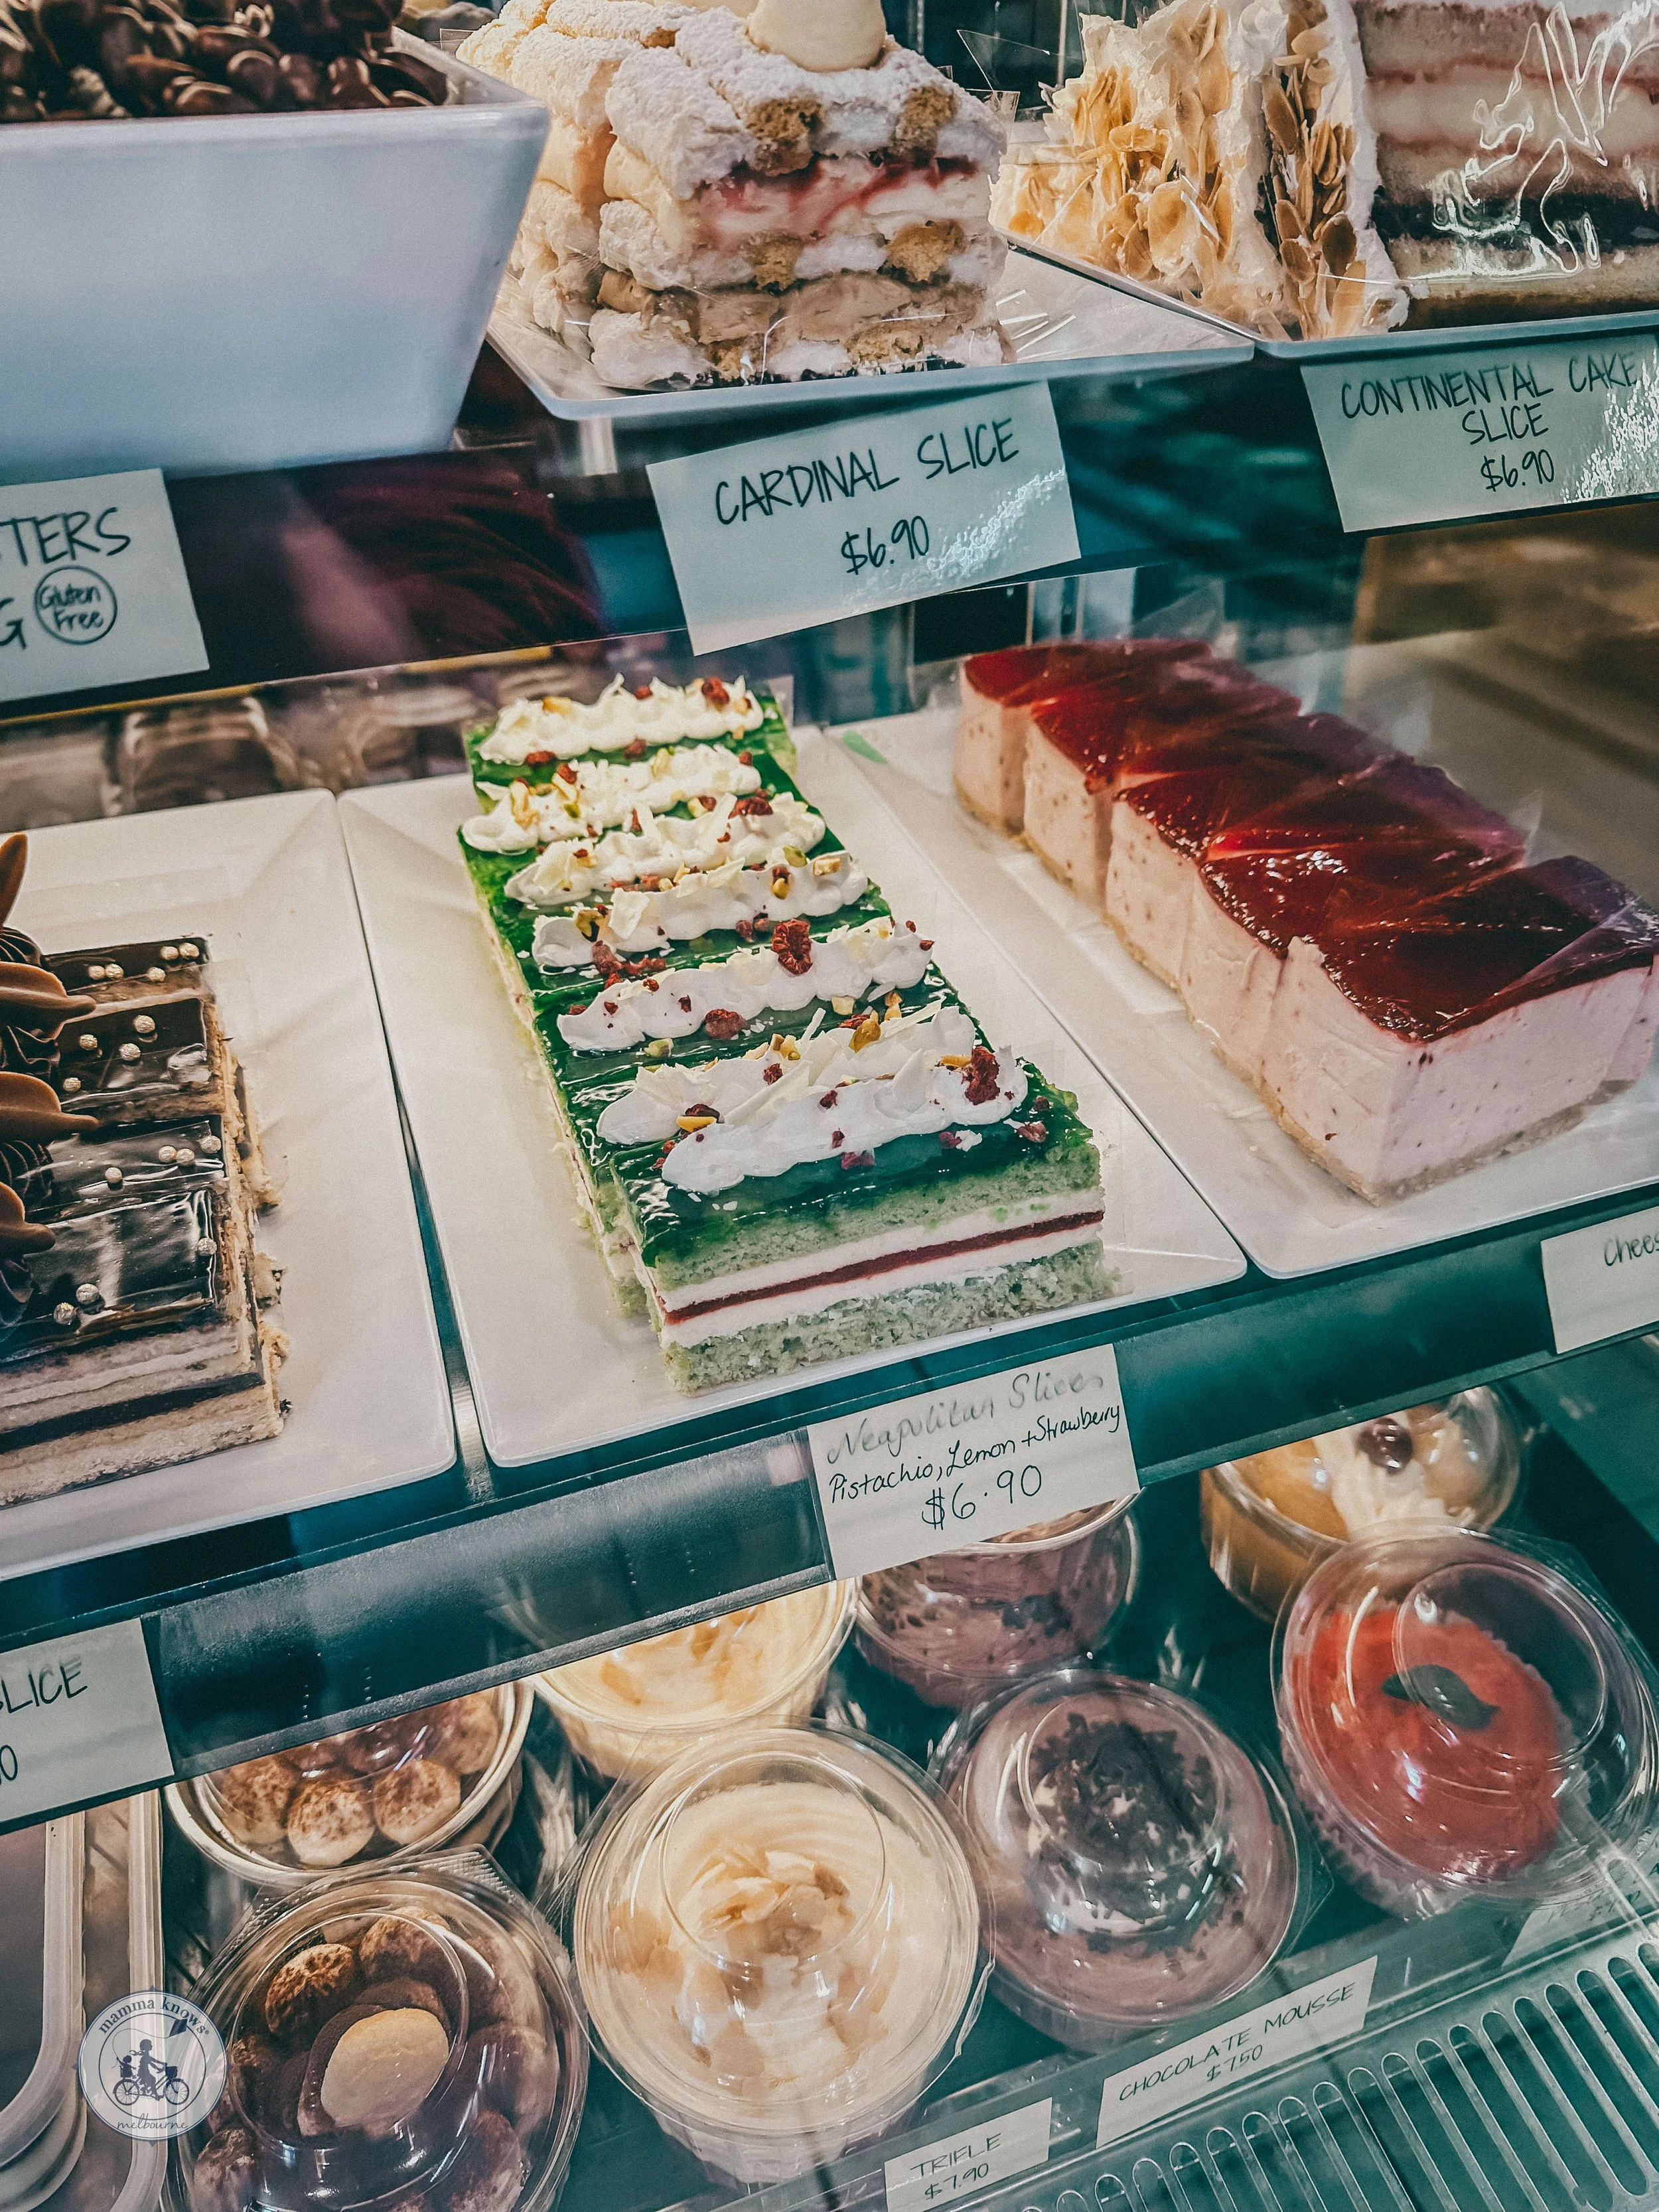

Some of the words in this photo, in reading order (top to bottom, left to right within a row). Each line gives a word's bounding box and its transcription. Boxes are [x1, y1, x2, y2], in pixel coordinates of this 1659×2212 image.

[1341, 364, 1553, 419] CONTINENTAL
[1568, 351, 1638, 392] CAKE
[1461, 403, 1549, 445] SLICE
[715, 449, 900, 524] CARDINAL
[917, 417, 1019, 480] SLICE
[1480, 449, 1554, 492] $6.90
[0, 506, 131, 565] TERS
[841, 515, 930, 575] $6.90
[40, 583, 102, 609] Gluten
[54, 609, 104, 631] Free
[921, 1464, 1043, 1530] $6.90
[0, 1655, 88, 1714] LICE
[1119, 2027, 1252, 2101] CHOCOLATE
[1264, 1982, 1355, 2033] MOUSSE
[910, 2133, 1001, 2177] TRIFLE
[924, 2163, 989, 2200] $7.90
